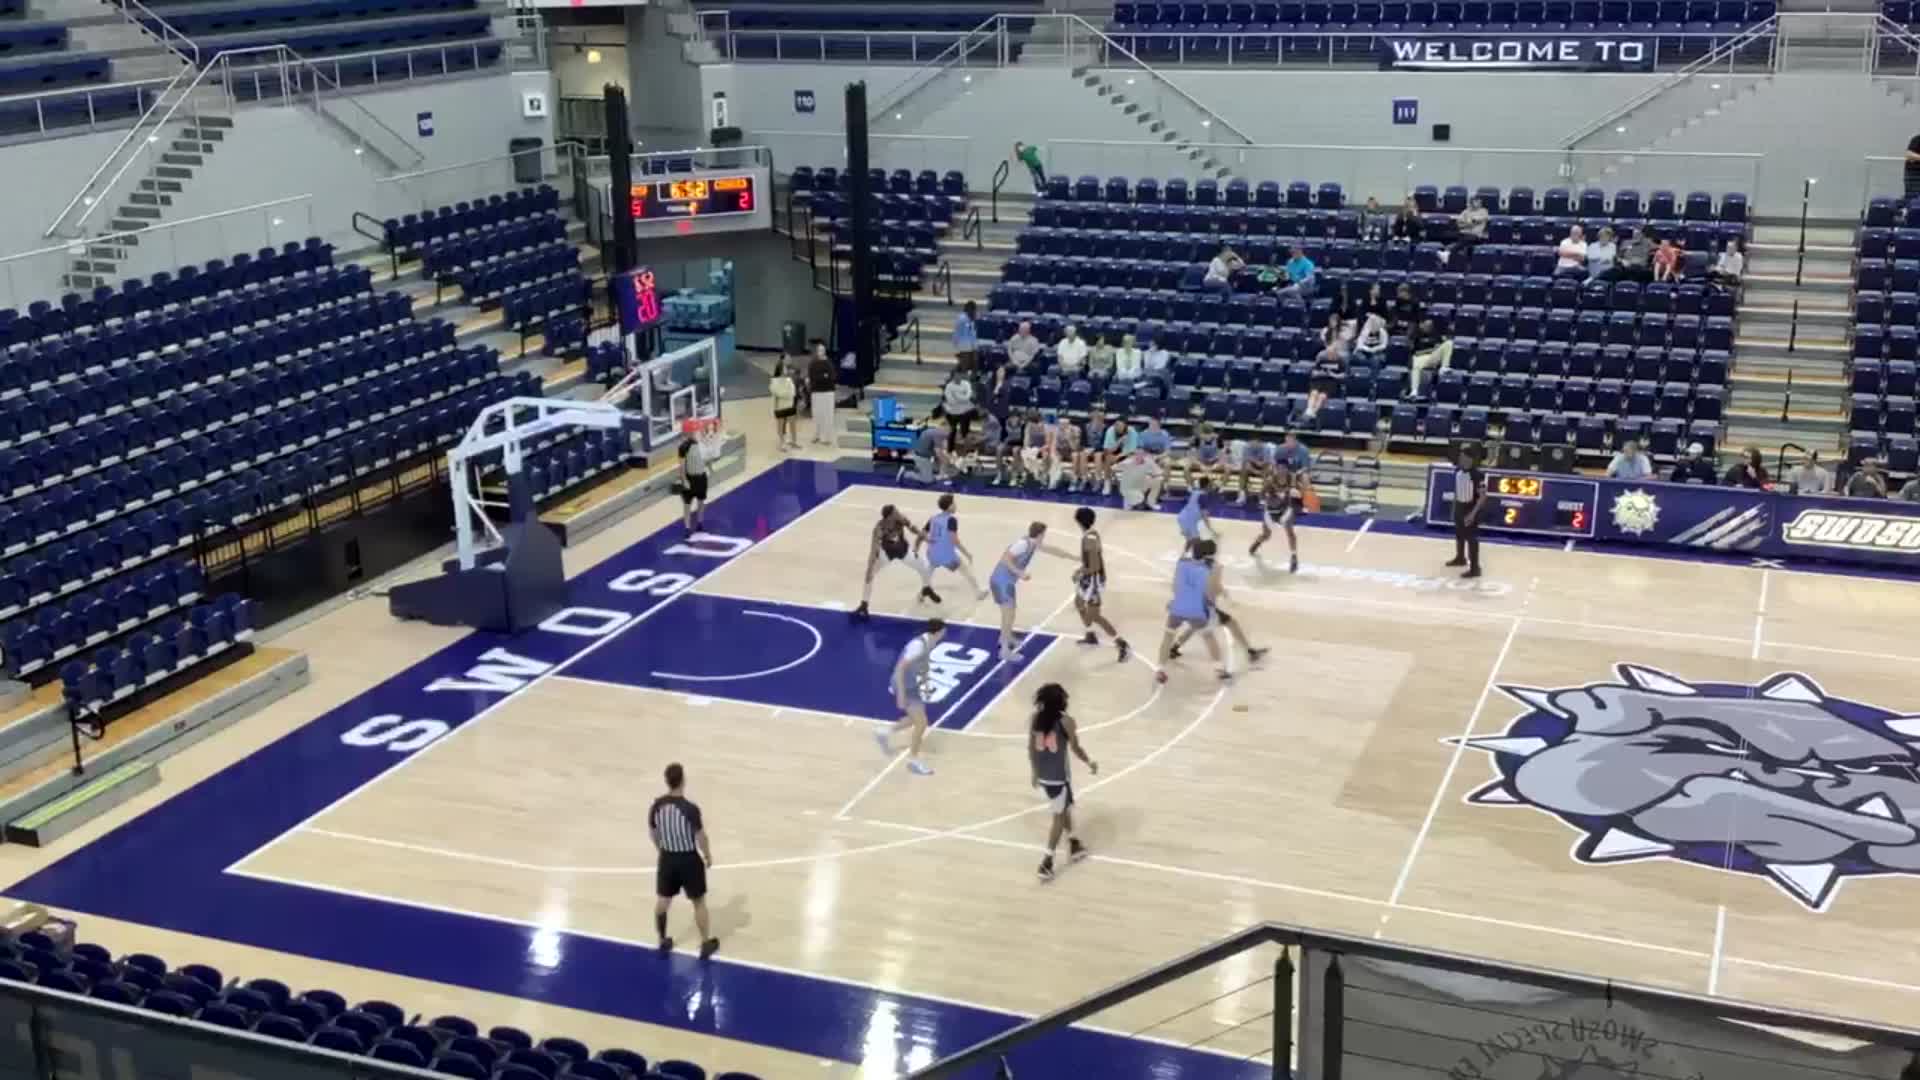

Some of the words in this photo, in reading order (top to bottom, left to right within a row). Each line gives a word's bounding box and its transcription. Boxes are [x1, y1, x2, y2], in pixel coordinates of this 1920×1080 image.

[1392, 41, 1580, 61] WELCOME
[1596, 42, 1644, 61] TO
[739, 191, 750, 208] 2
[1498, 478, 1539, 495] 6:52
[1503, 508, 1517, 524] 2
[1571, 512, 1585, 528] 2
[340, 532, 753, 751] SWOSU
